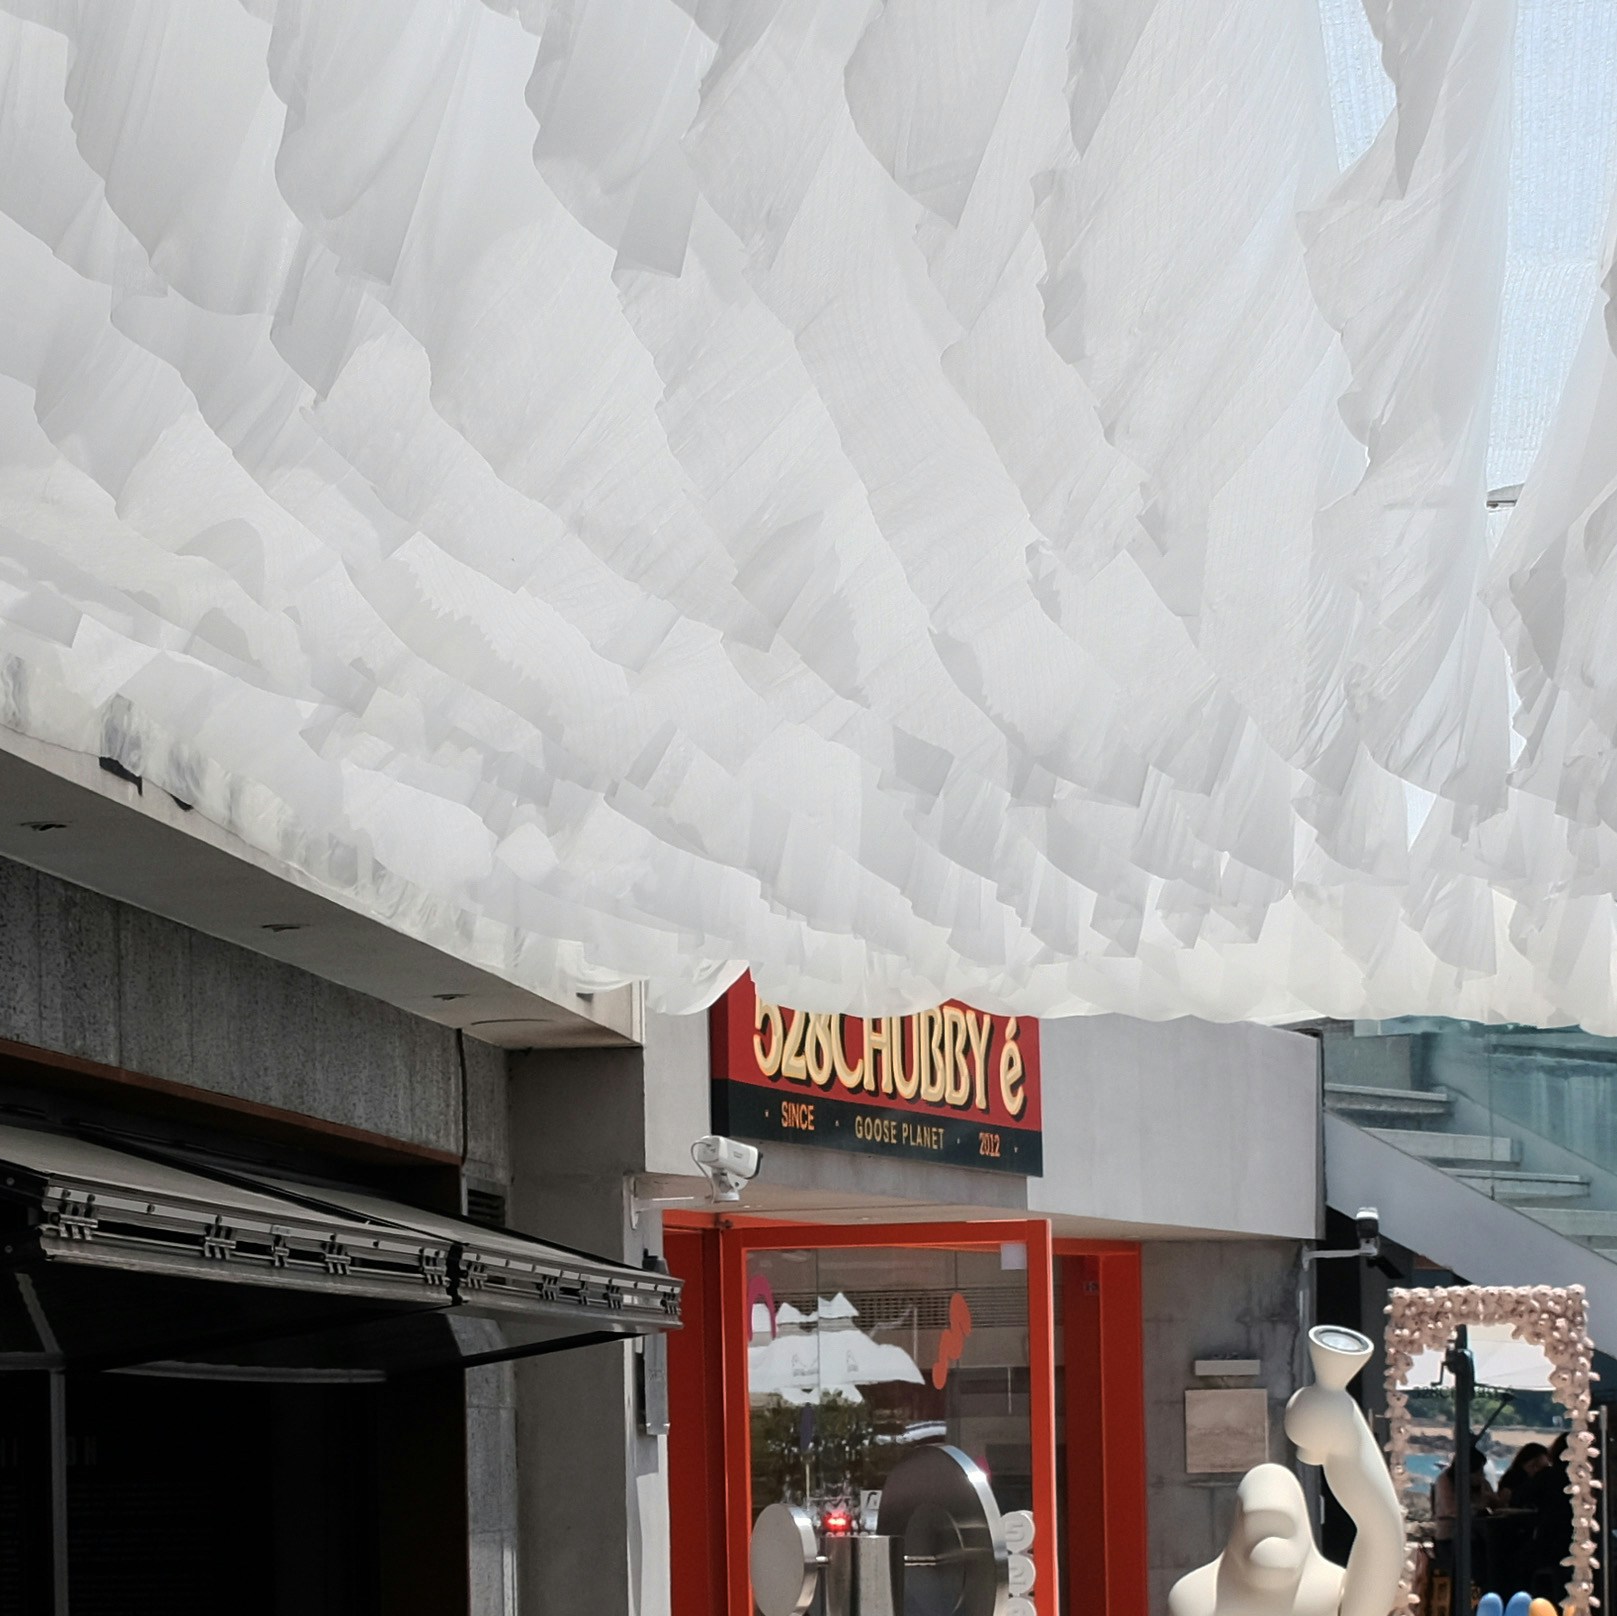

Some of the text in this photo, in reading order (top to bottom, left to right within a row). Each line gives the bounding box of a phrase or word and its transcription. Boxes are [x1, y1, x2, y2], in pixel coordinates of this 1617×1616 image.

[781, 1101, 815, 1130] SINCE
[855, 1115, 897, 1144] GOOSE
[902, 1122, 944, 1150] PLANET
